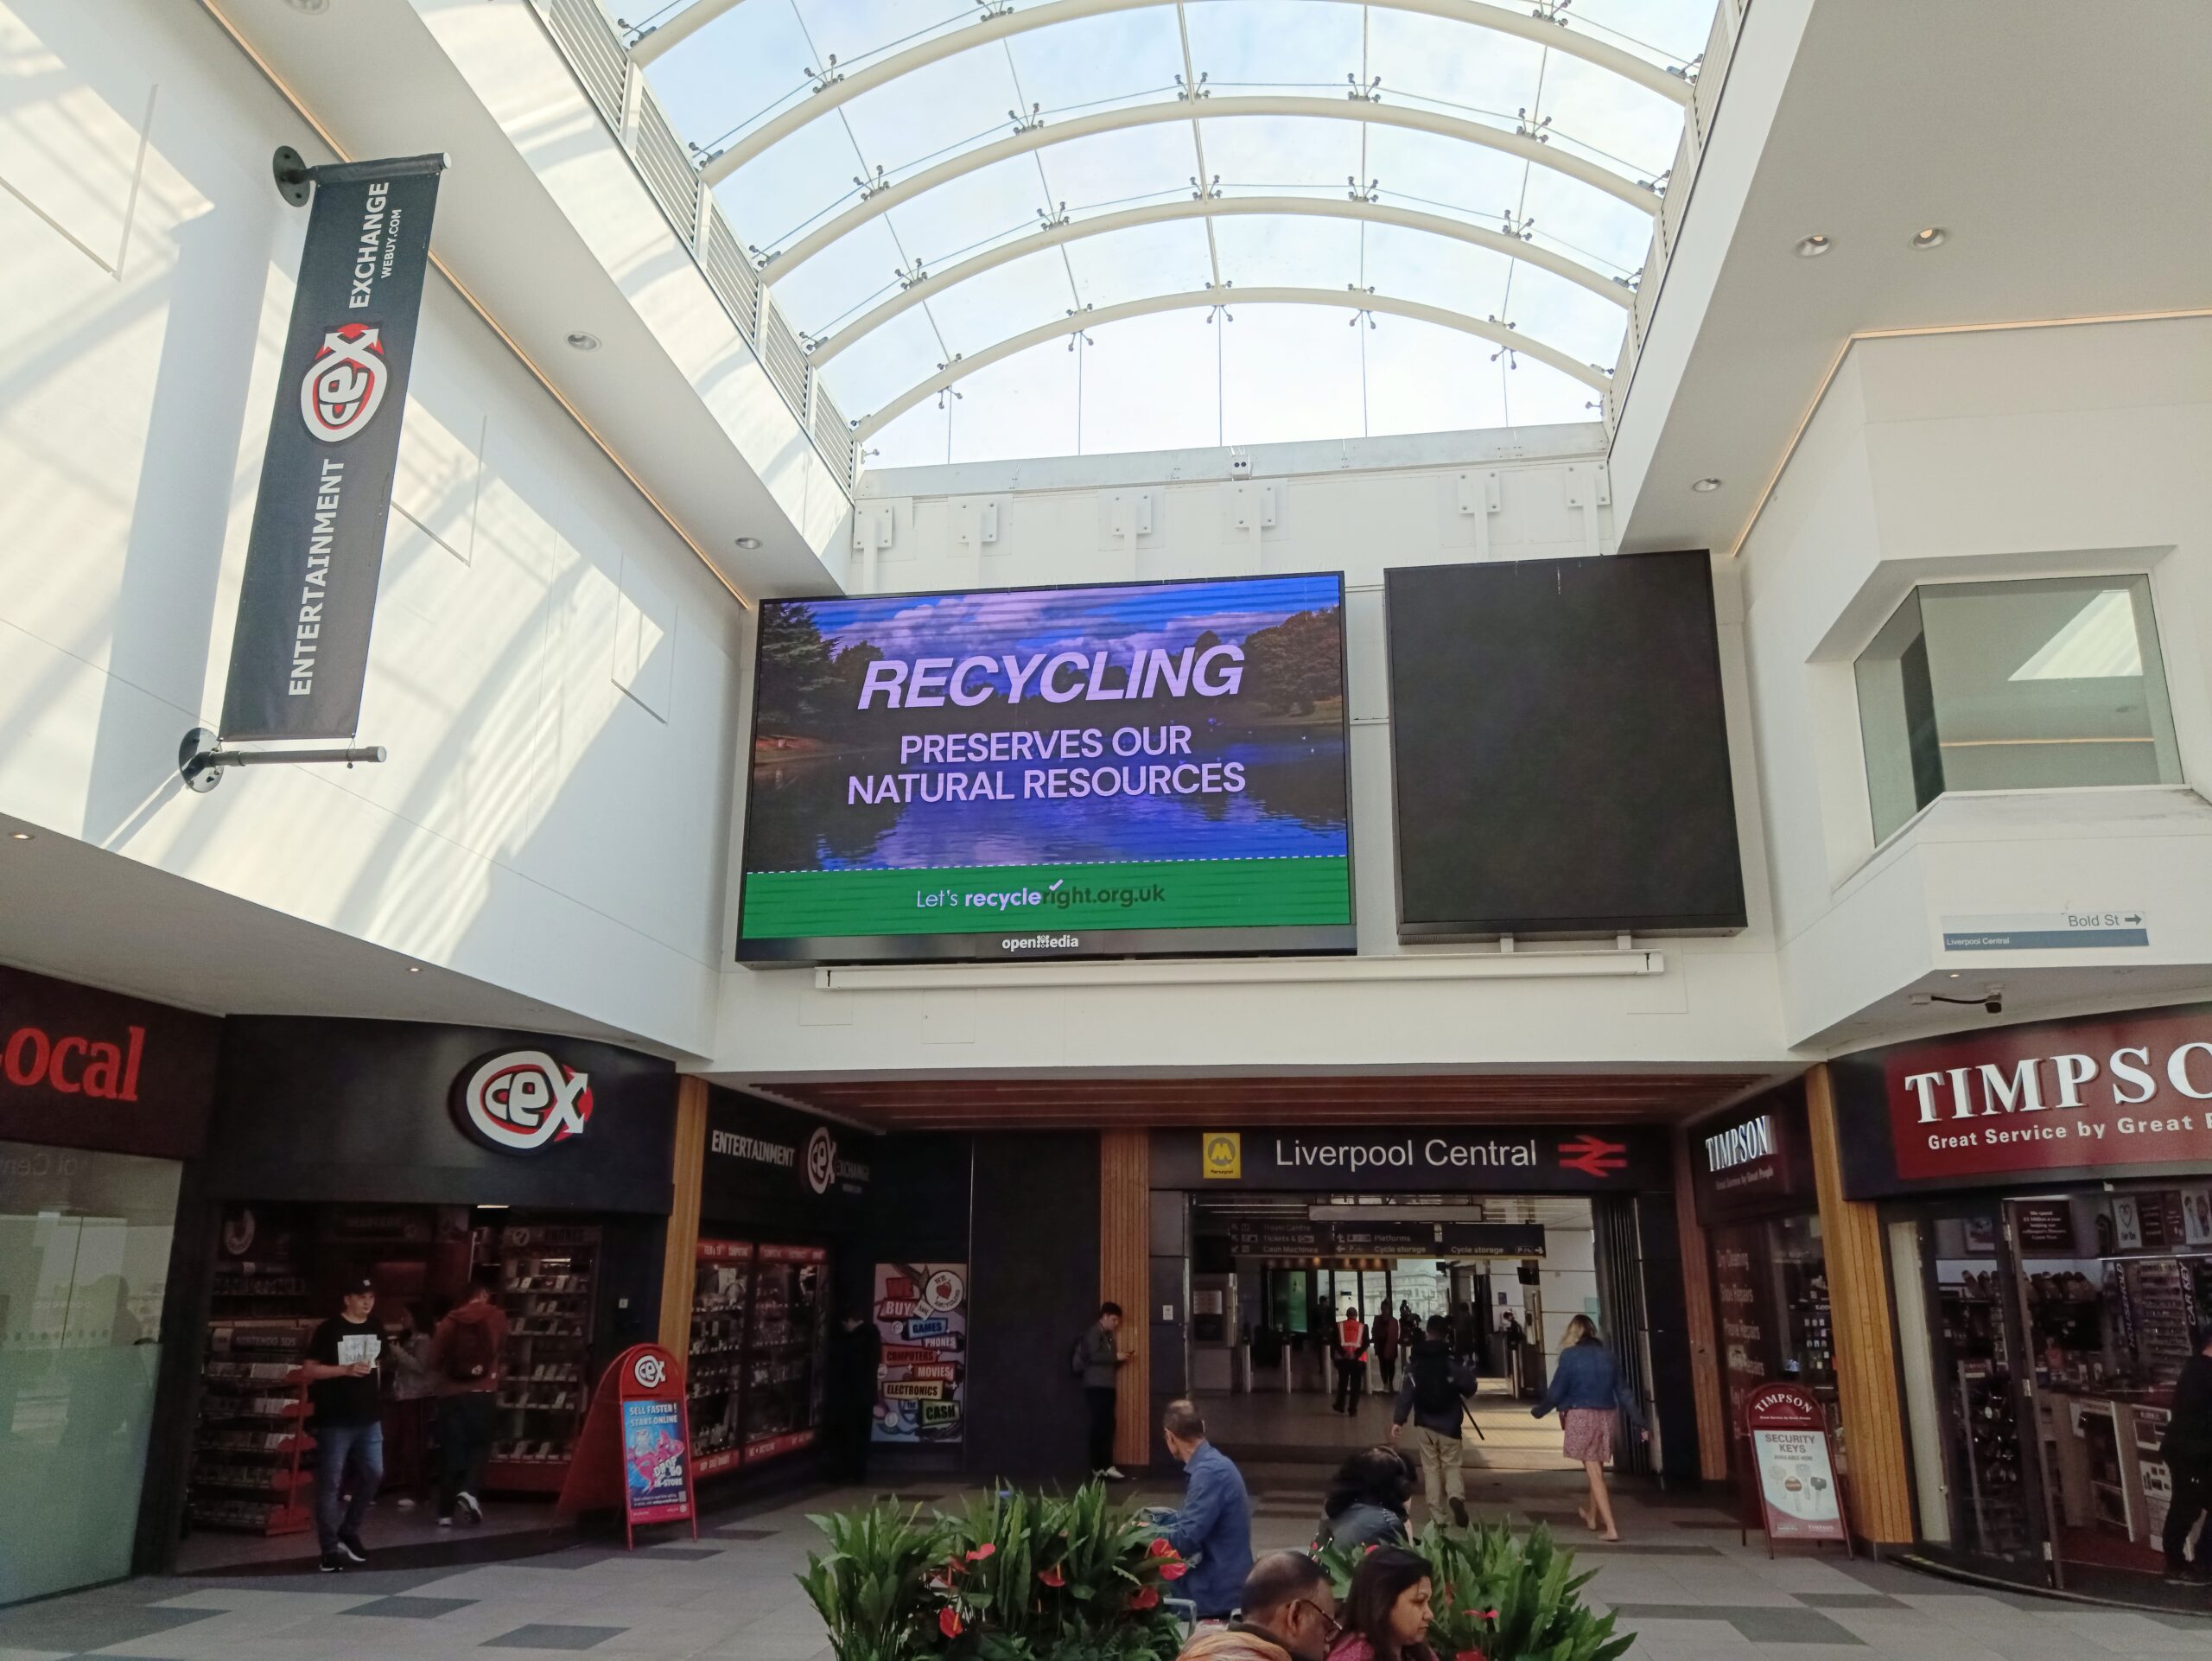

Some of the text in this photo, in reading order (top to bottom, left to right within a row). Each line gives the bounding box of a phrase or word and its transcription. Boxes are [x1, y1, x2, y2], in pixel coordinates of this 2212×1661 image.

[349, 181, 389, 309] EXCHANGE
[381, 209, 402, 279] WEBUY.COM
[289, 458, 344, 696] ENTERTAINMENT
[857, 645, 1246, 710] RECYCLING
[900, 725, 1192, 765] PRESERVES OUR
[848, 762, 1246, 805] NATURAL RESOURCES
[917, 889, 958, 908] Let's
[2068, 913, 2120, 927] Bold St
[1946, 937, 2010, 946] Liverpool Central
[0, 1025, 146, 1102] ocal
[1928, 1133, 1978, 1150] Great
[1986, 1124, 2068, 1145] Service
[2077, 1121, 2106, 1140] by
[2117, 1116, 2194, 1135] Great
[711, 1129, 795, 1168] ENTERTAINMENT
[1706, 1115, 1771, 1172] TIMPSON
[1276, 1139, 1537, 1172] Liverpool Central
[1374, 1245, 1395, 1255] Cycle
[1452, 1246, 1472, 1255] Cycle
[1473, 1246, 1504, 1255] storage
[2179, 1261, 2196, 1327] CAR KEY
[886, 1300, 912, 1315] BUY
[912, 1321, 942, 1333] GAMES
[925, 1336, 955, 1348] PHONES
[887, 1351, 933, 1362] COMPUTERS
[918, 1366, 950, 1378] MOVIES
[887, 1384, 938, 1396] ELECTRONICS
[629, 1406, 645, 1416] SELL
[1754, 1393, 1814, 1414] TIMPSON
[925, 1404, 956, 1420] CASH
[630, 1415, 678, 1427] START ONLINE
[1764, 1434, 1815, 1444] SECURITY
[1778, 1444, 1807, 1454] KEYS
